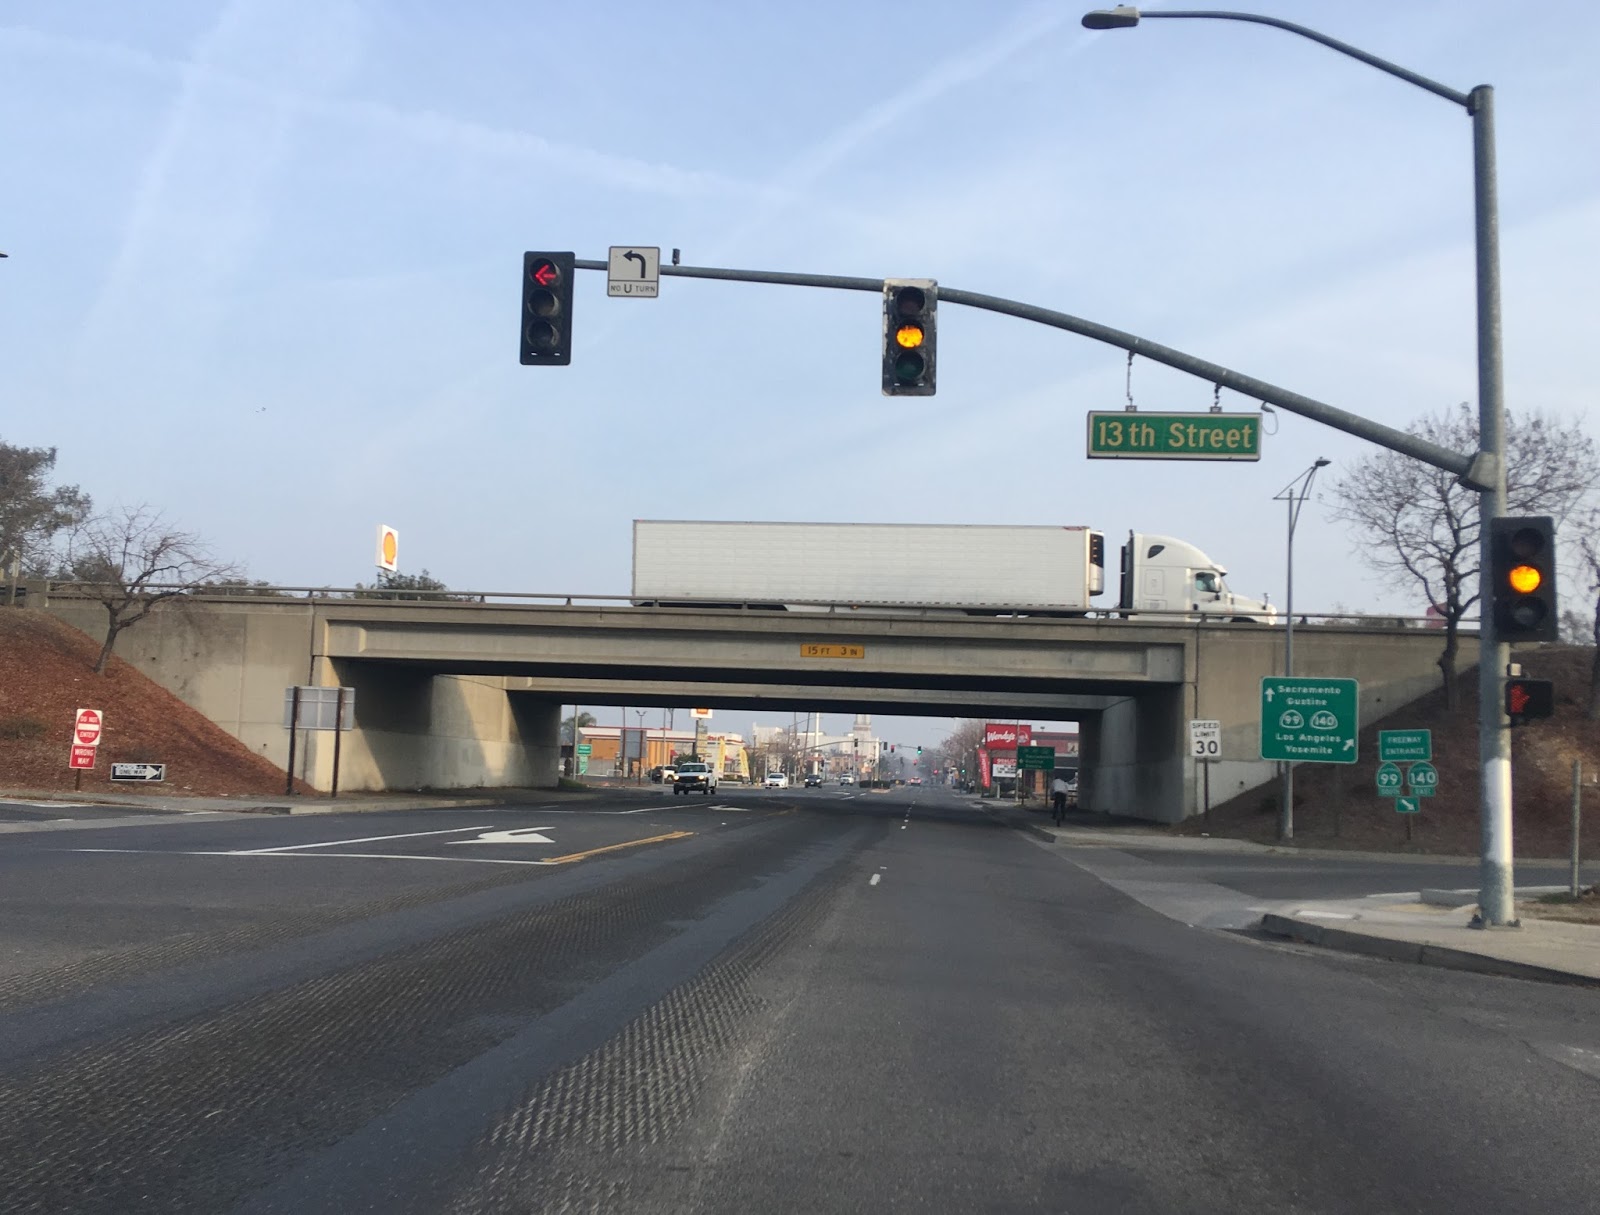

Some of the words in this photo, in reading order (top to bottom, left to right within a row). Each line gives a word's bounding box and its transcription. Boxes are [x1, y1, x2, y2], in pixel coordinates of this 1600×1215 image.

[624, 284, 632, 293] U
[1099, 421, 1155, 447] 13th
[1168, 422, 1253, 449] Street
[808, 646, 818, 655] 15
[840, 646, 847, 656] 3
[1277, 685, 1341, 695] Sacramento
[1286, 697, 1328, 706] Gustine
[1283, 715, 1301, 725] 99
[1315, 716, 1335, 726] 140
[1275, 732, 1295, 741] Los
[1299, 733, 1341, 743] Angeles
[74, 748, 94, 756] WRONG
[1196, 740, 1218, 754] 30
[1285, 745, 1333, 754] Yosemite
[77, 757, 90, 765] WAY
[1380, 773, 1398, 785] 99
[1410, 771, 1436, 784] 140
